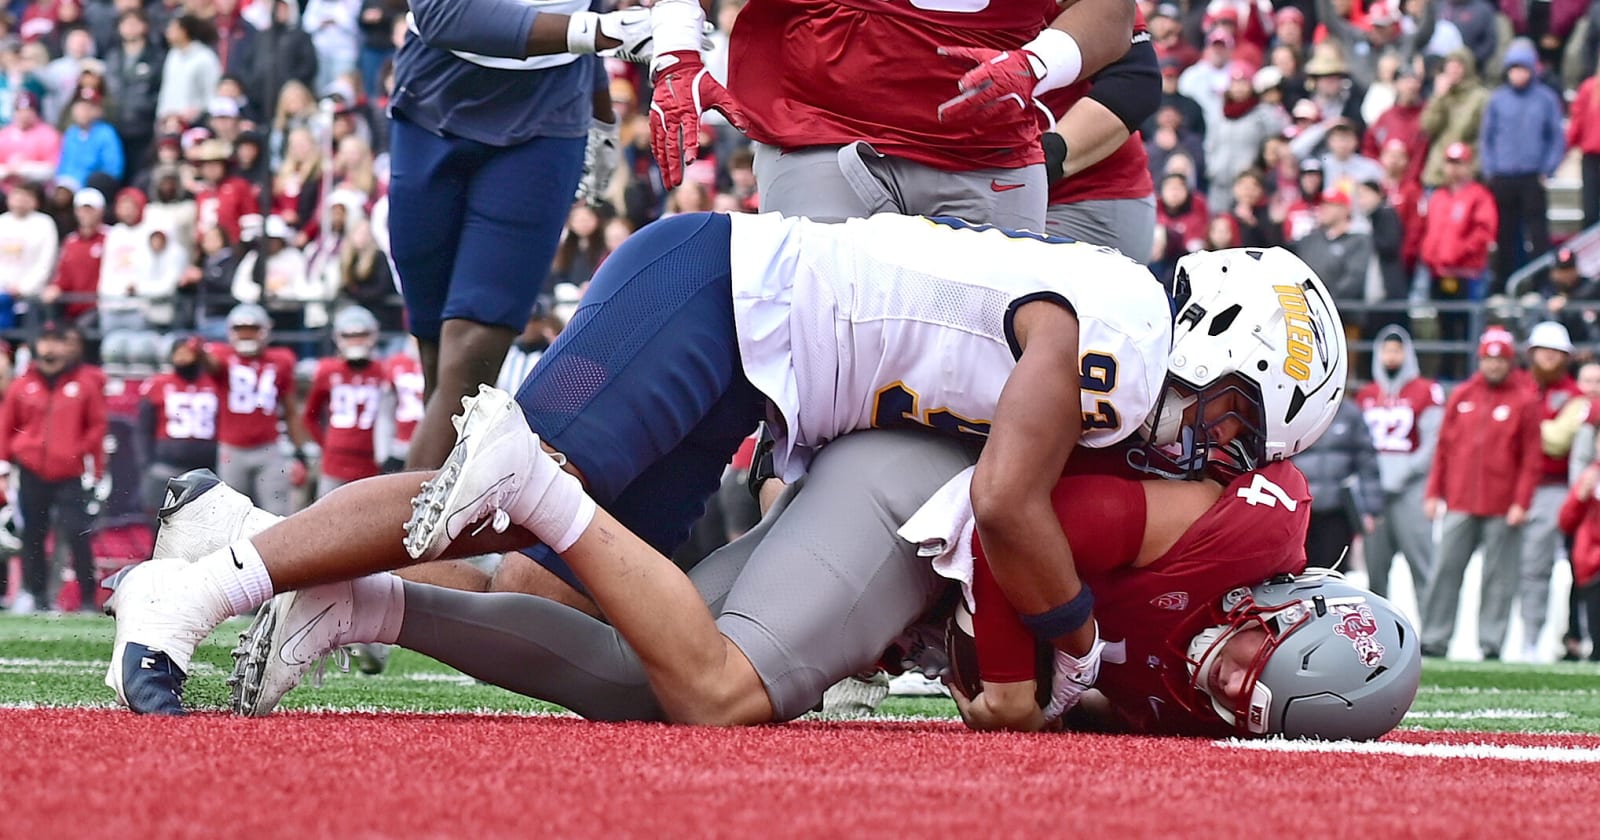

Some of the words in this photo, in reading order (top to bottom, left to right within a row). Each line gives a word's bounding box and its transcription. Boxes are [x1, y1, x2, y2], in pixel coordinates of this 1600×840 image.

[1271, 283, 1314, 381] TOLEDO
[228, 364, 278, 416] 84
[330, 383, 380, 430] 97
[164, 391, 218, 439] 58
[1237, 474, 1297, 512] 4
